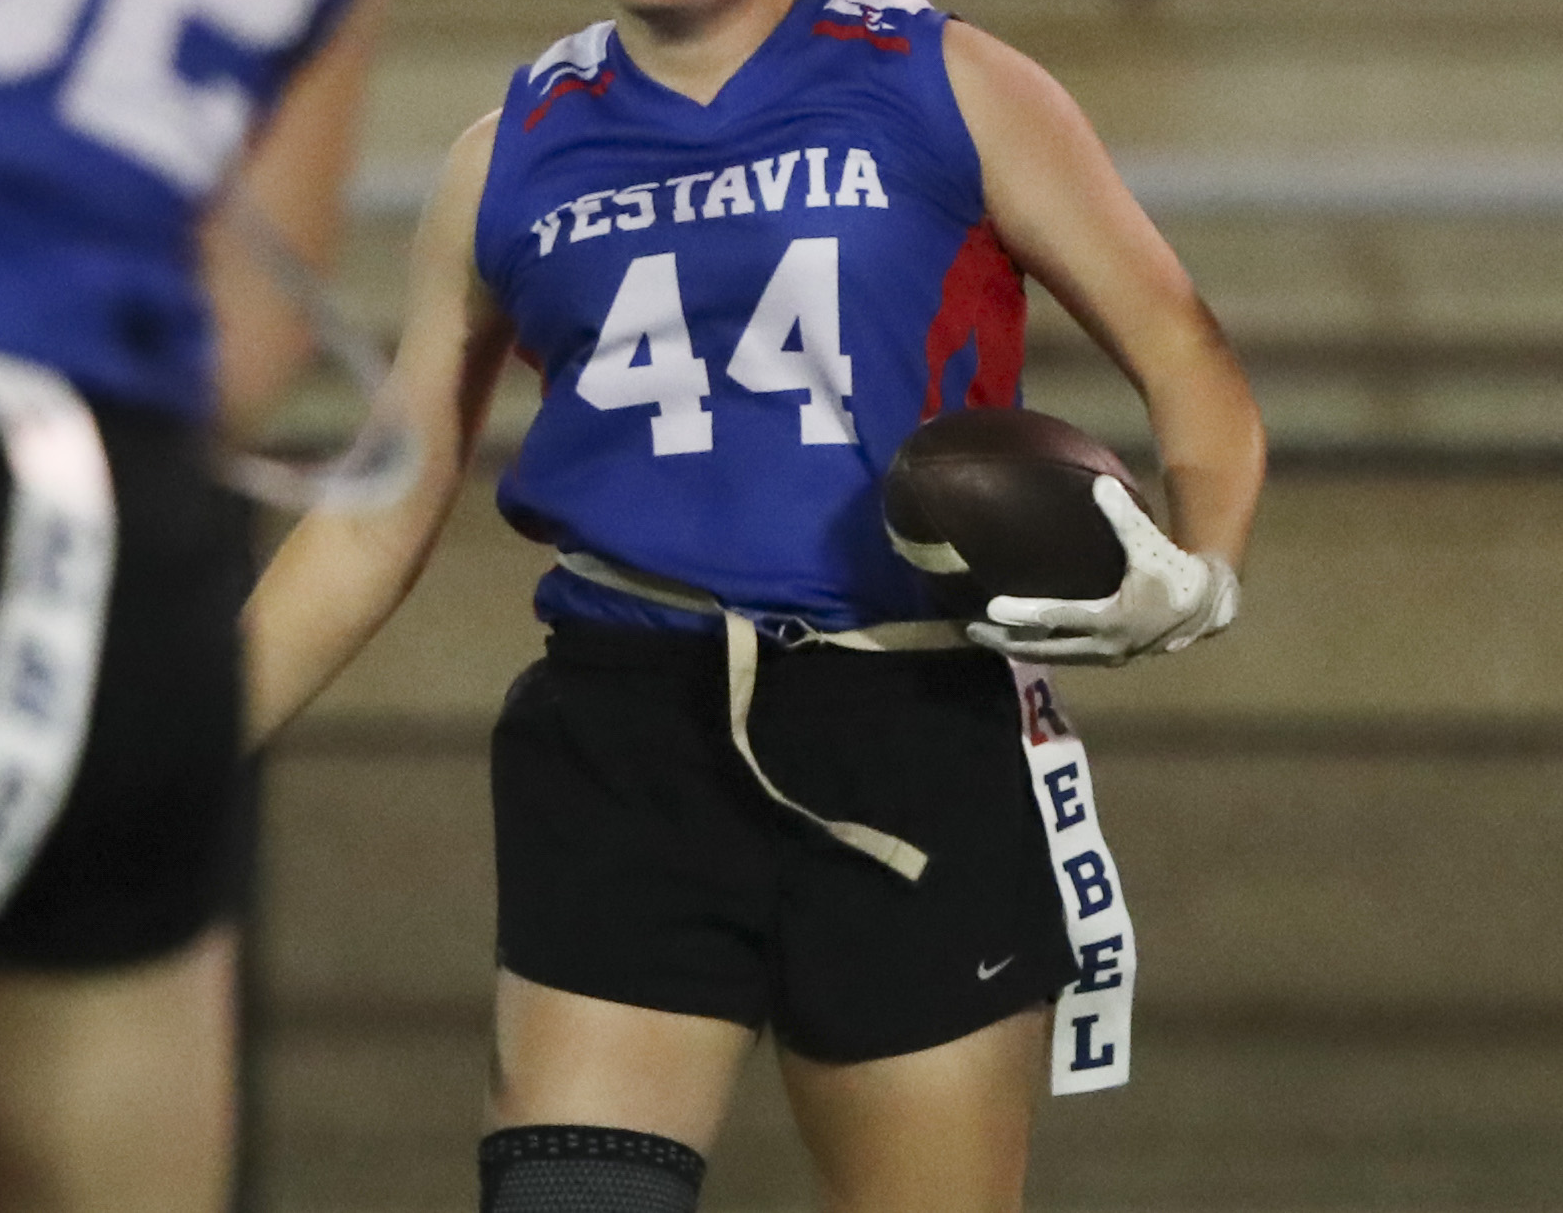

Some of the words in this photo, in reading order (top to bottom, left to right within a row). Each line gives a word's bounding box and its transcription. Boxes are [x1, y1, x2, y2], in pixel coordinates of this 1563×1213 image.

[530, 147, 889, 257] VESTAVIA
[575, 236, 859, 457] 44
[1023, 678, 1124, 1073] REBEL
